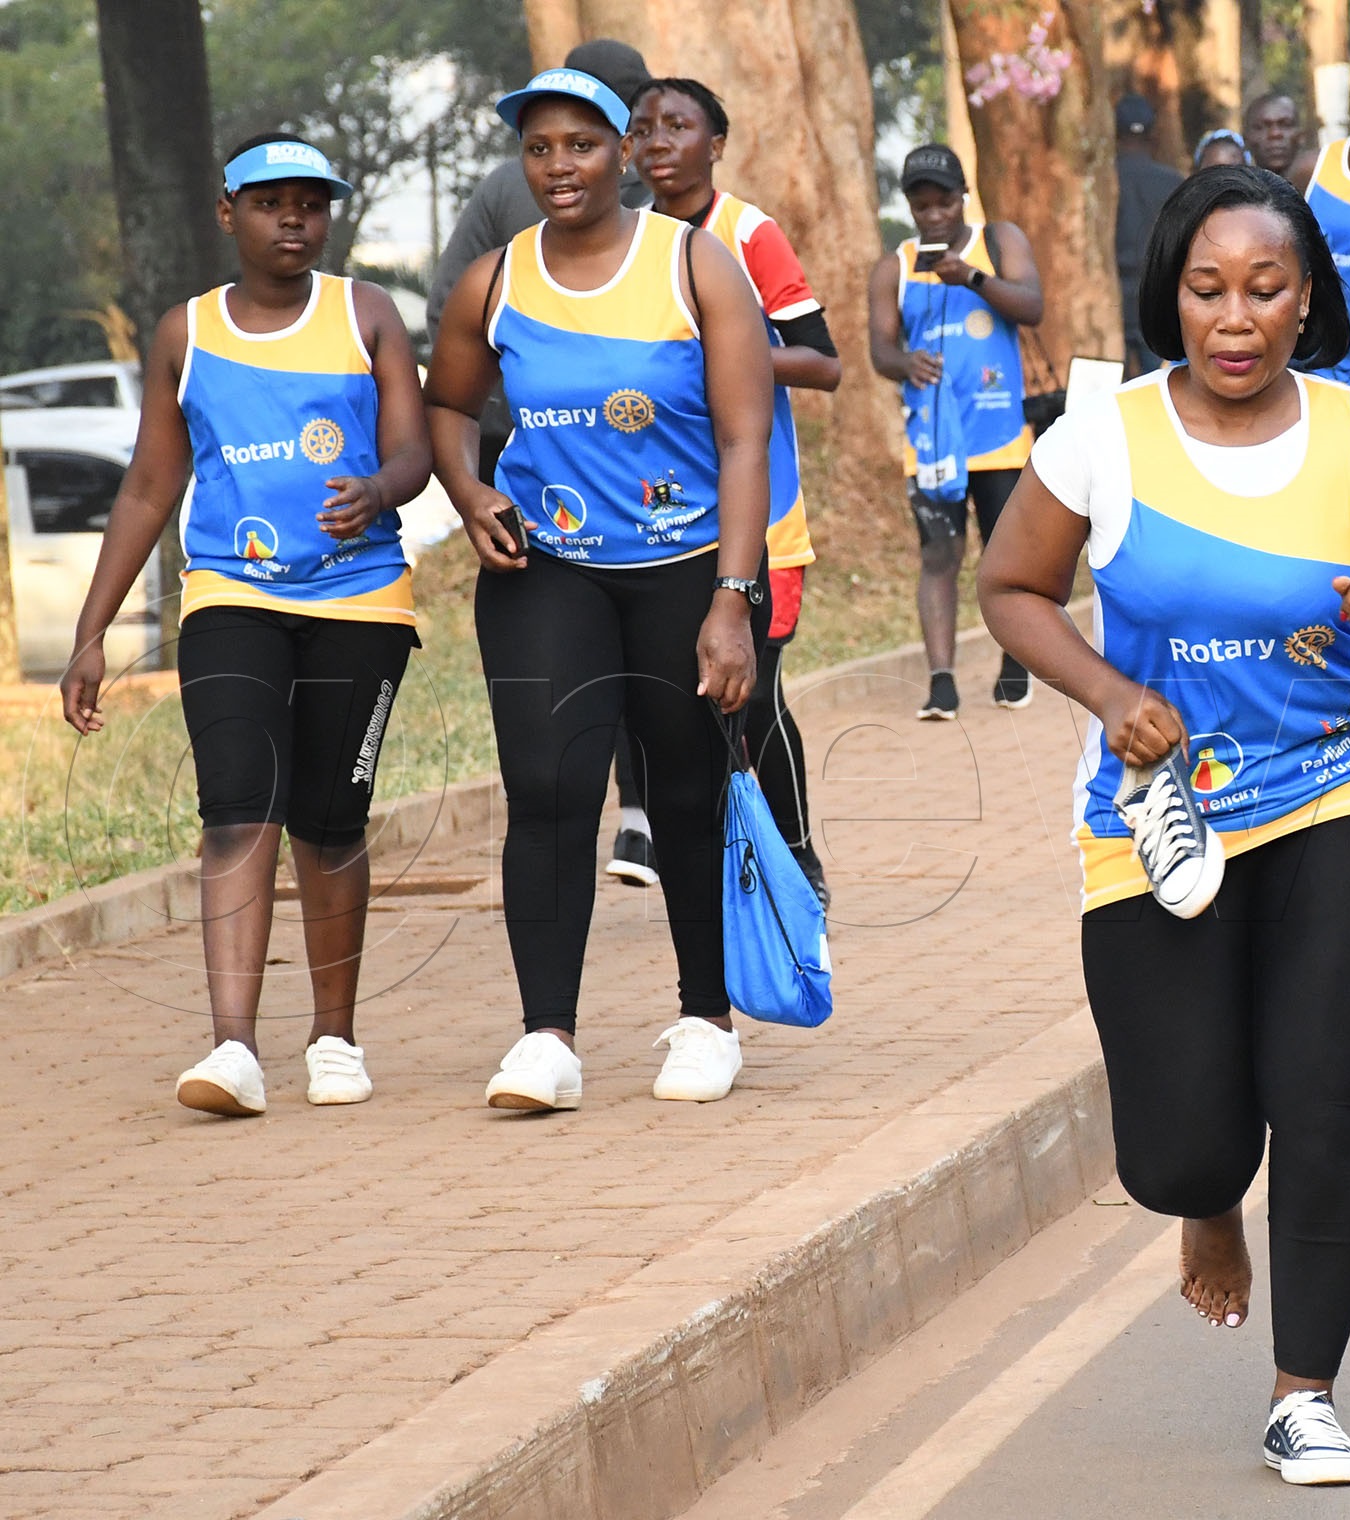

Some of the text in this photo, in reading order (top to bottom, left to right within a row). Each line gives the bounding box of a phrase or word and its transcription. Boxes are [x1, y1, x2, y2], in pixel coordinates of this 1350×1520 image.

[519, 407, 596, 429] Rotary
[221, 439, 295, 465] Rotary
[243, 562, 275, 581] Bank
[1169, 637, 1276, 663] Rotary
[1315, 768, 1333, 784] of
[1195, 785, 1260, 814] ntenary
